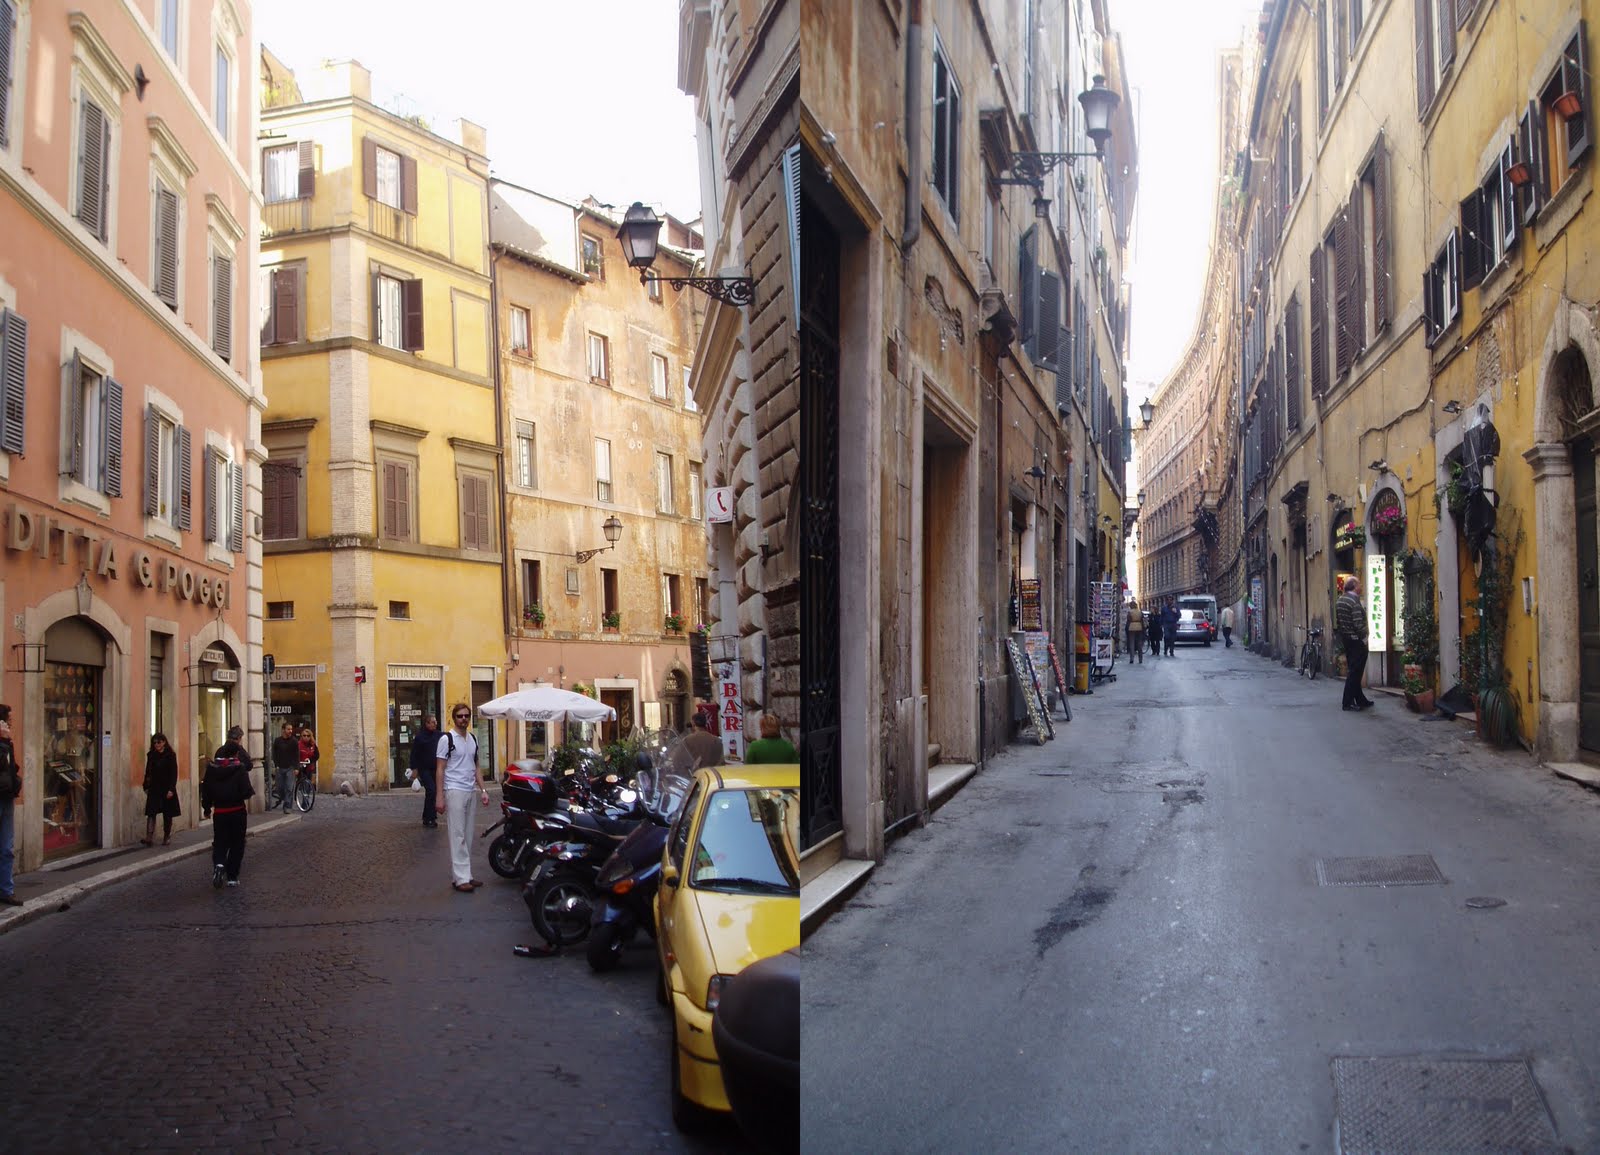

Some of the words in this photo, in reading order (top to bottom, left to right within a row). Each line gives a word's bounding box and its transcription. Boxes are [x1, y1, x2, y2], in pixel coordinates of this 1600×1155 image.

[7, 503, 119, 580] DITTA
[160, 556, 230, 611] POGGI
[1372, 567, 1382, 639] PIZZERIA
[286, 668, 315, 680] POGGI
[388, 667, 409, 679] DITTA
[419, 667, 440, 680] POGGI
[723, 682, 740, 731] BAR
